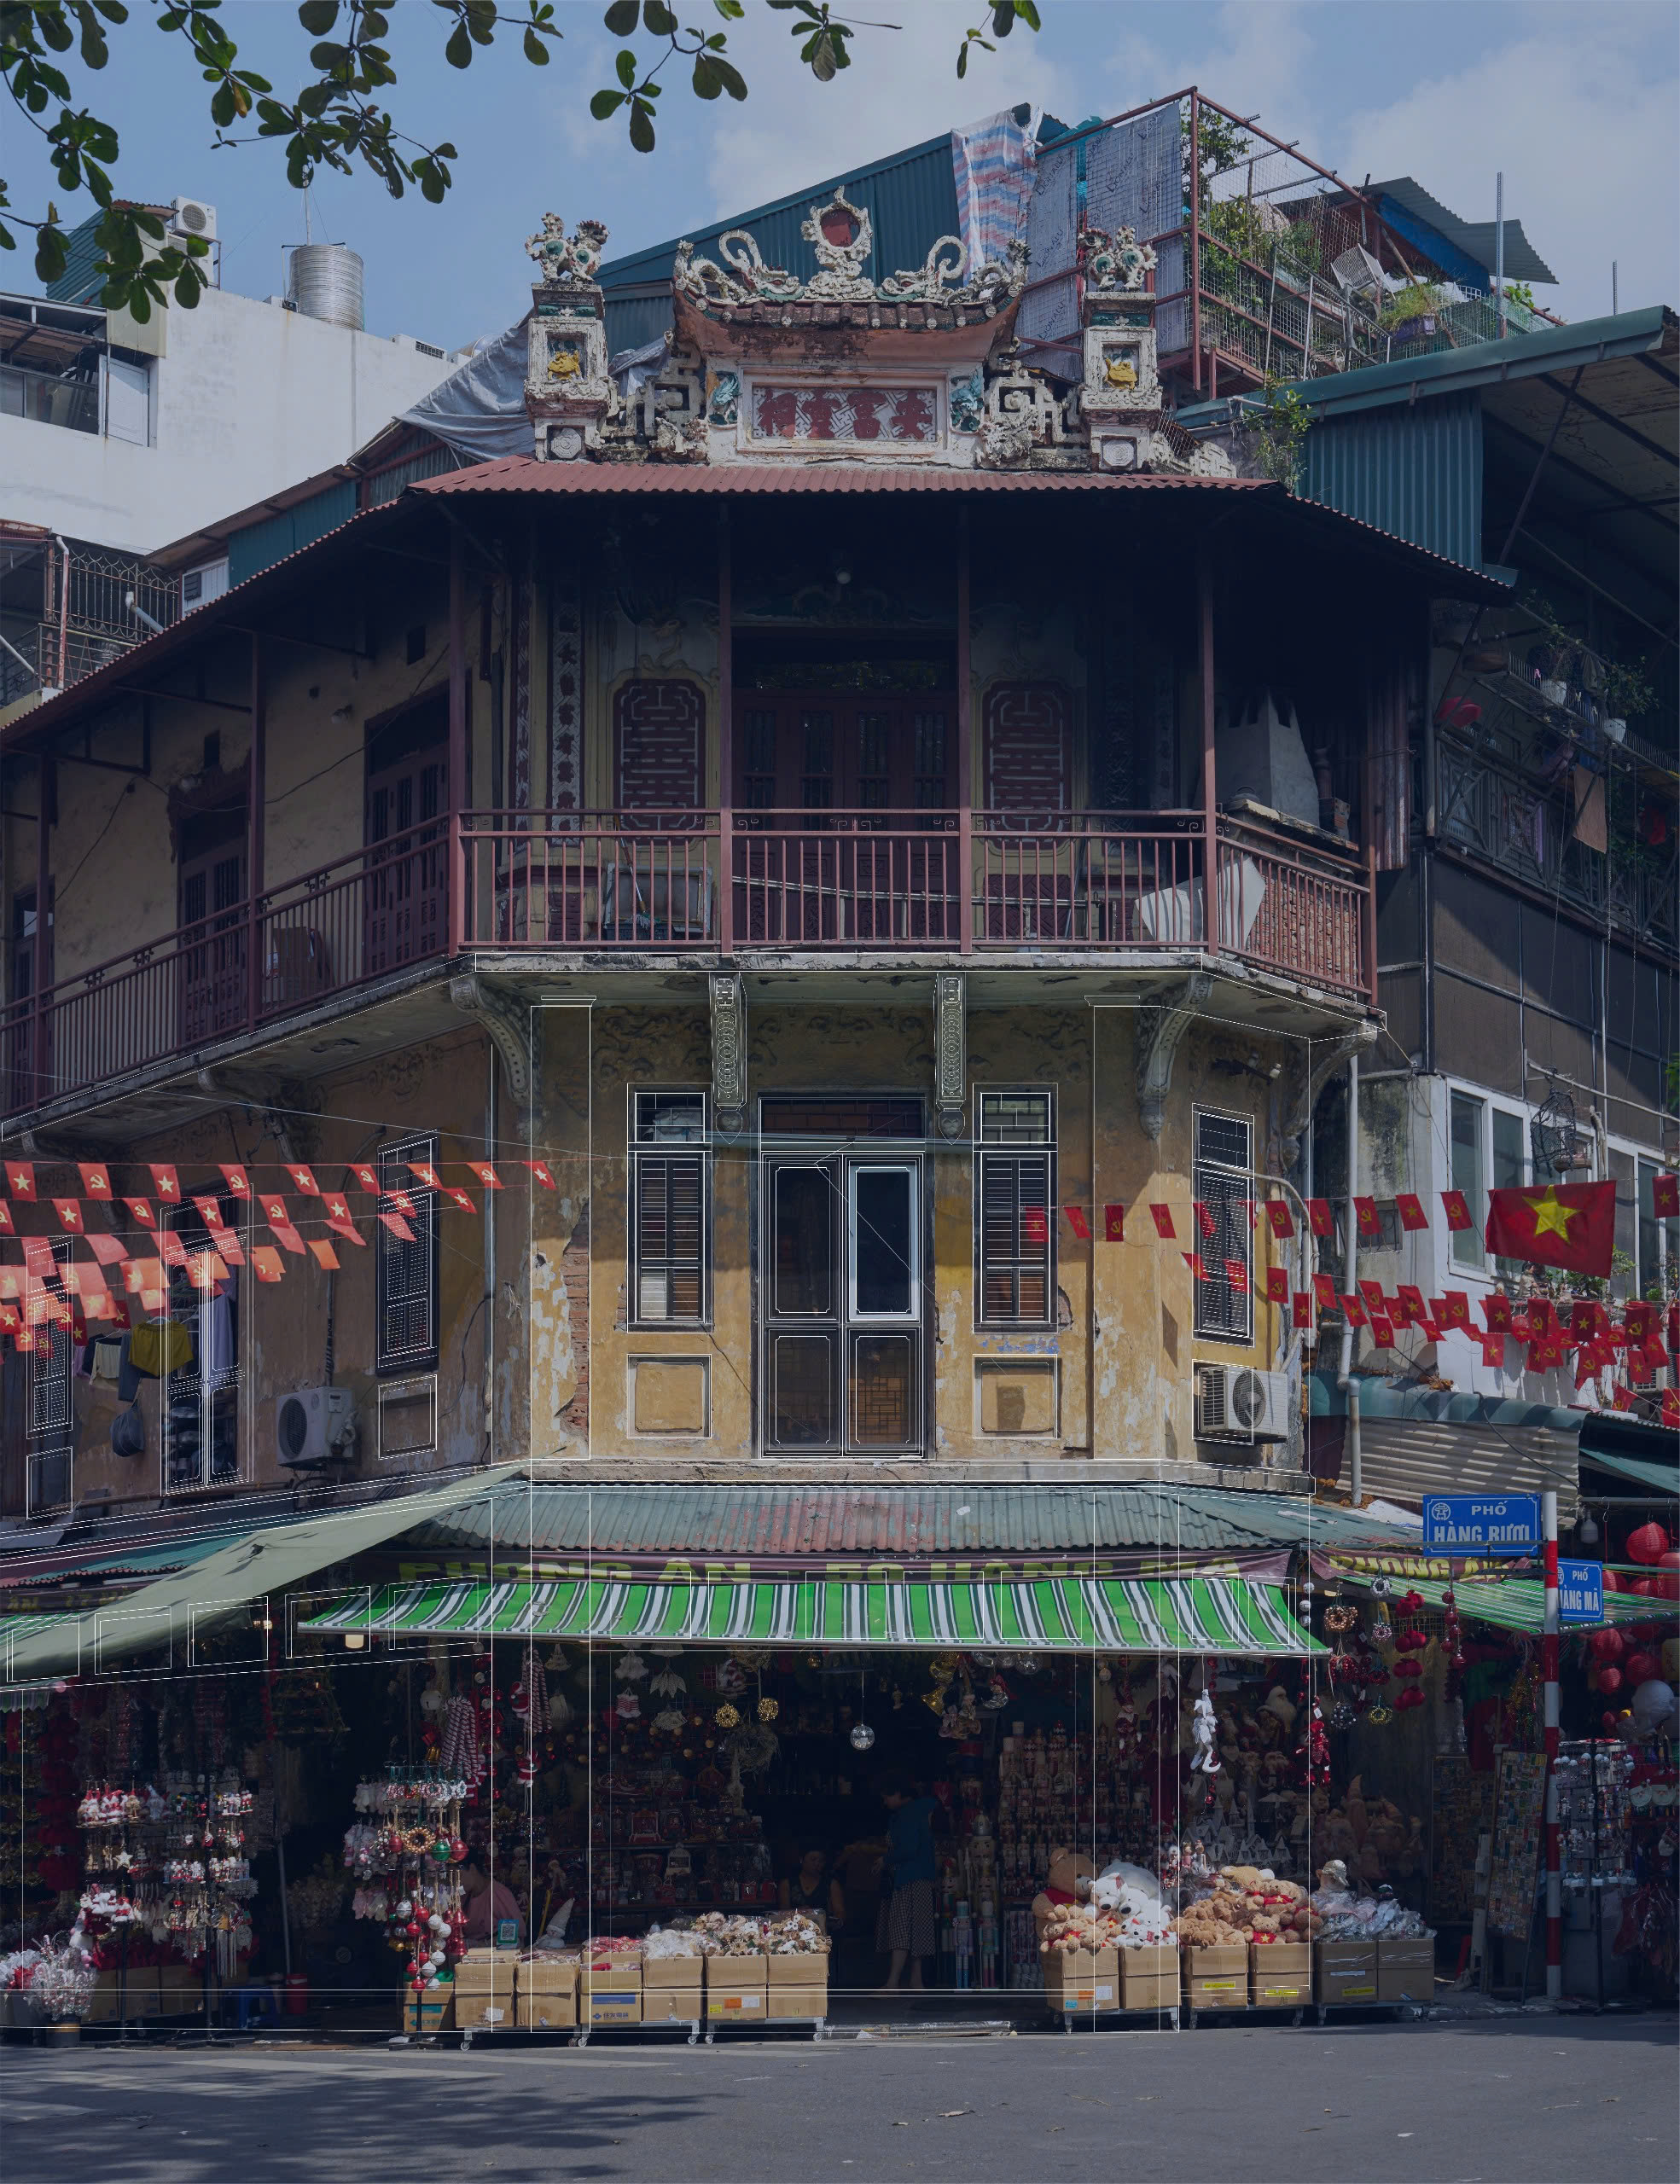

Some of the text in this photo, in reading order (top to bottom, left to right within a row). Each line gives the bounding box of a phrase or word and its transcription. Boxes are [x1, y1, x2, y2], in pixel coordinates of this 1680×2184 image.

[1471, 1500, 1509, 1516] PHỐ
[1433, 1520, 1530, 1542] HÀNG RƯƠI
[656, 1557, 751, 1583] ÂN
[1328, 1554, 1450, 1579] PHONG
[1572, 1566, 1589, 1582] PHỐ
[1584, 1587, 1600, 1612] MÃ
